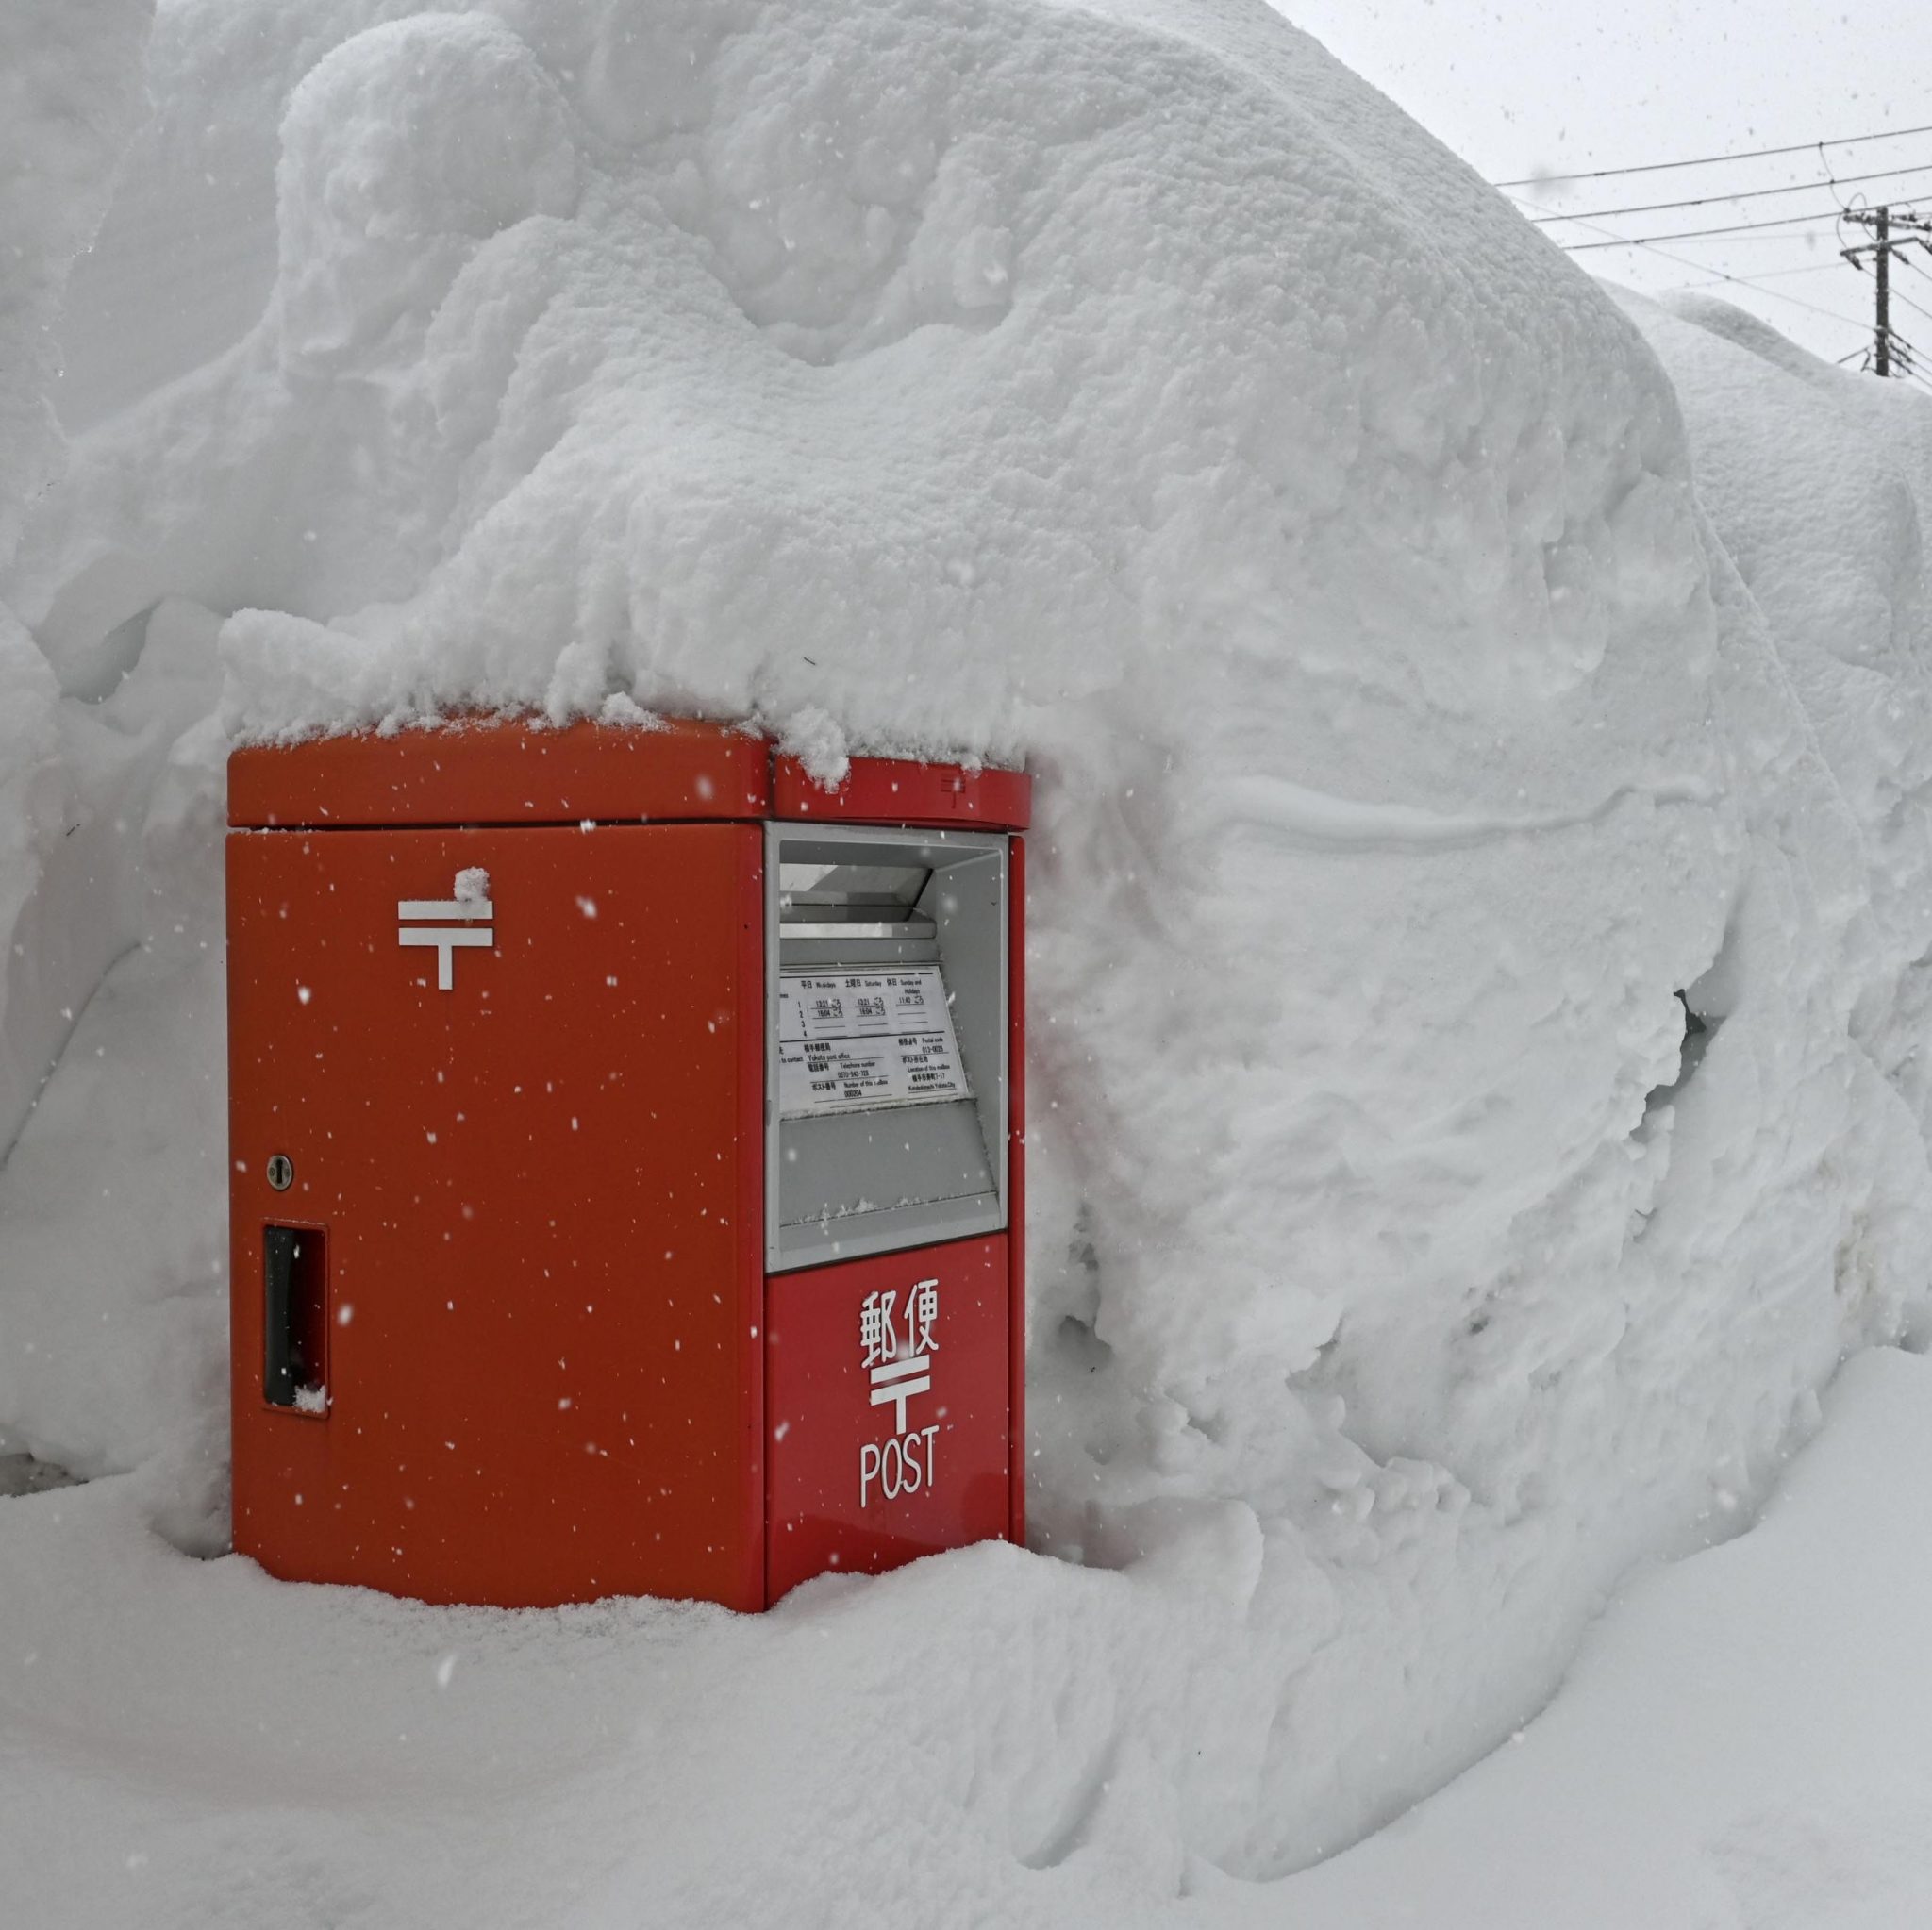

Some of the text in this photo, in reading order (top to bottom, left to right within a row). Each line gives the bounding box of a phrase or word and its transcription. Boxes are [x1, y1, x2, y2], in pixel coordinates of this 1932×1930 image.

[801, 980, 812, 989] 平日
[845, 978, 861, 987] 土曜日
[860, 1278, 940, 1369] 郵便
[859, 1424, 941, 1509] POST
